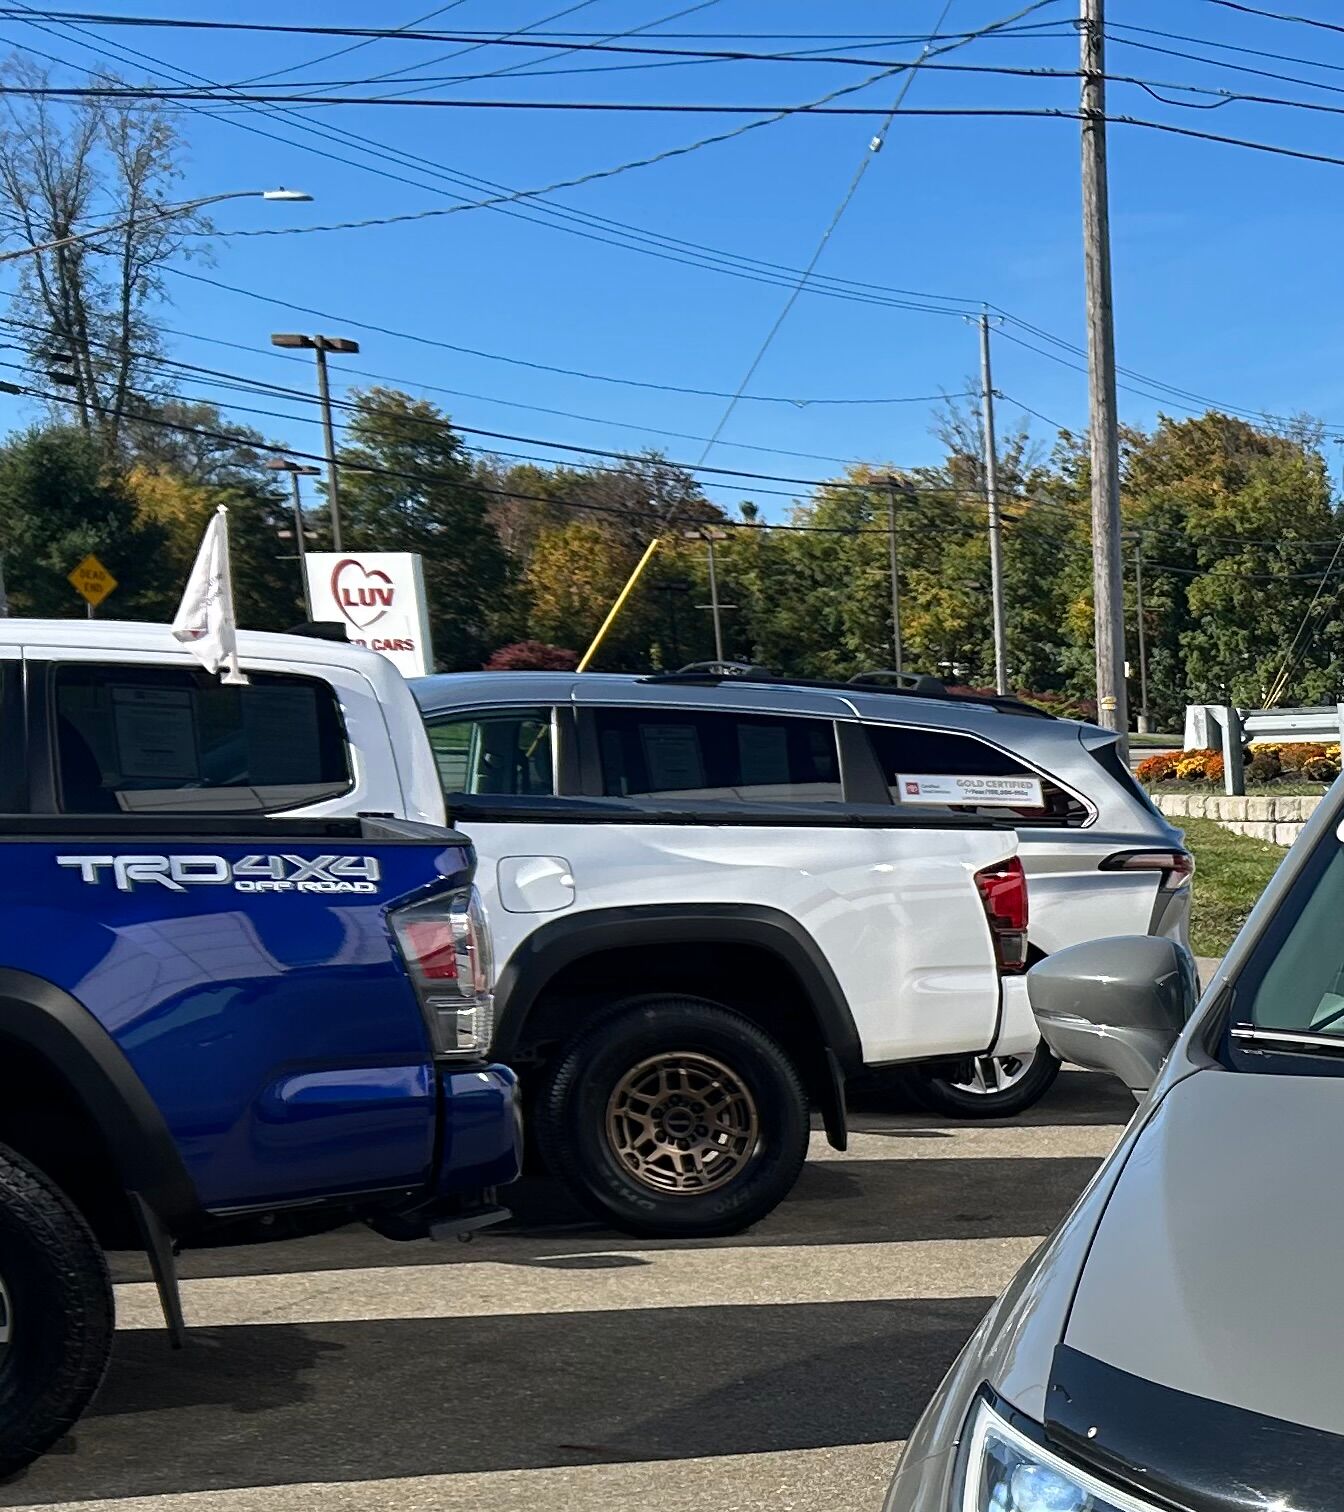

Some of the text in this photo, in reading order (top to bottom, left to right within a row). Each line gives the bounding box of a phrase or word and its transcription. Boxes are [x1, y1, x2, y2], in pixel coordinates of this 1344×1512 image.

[79, 568, 106, 580] DEAD
[84, 582, 103, 593] END
[341, 587, 395, 607] LUV
[371, 638, 416, 651] CARS
[956, 778, 1034, 789] GOLD CERTIFIED
[56, 855, 234, 892] TRD
[234, 880, 380, 894] OFF ROAD
